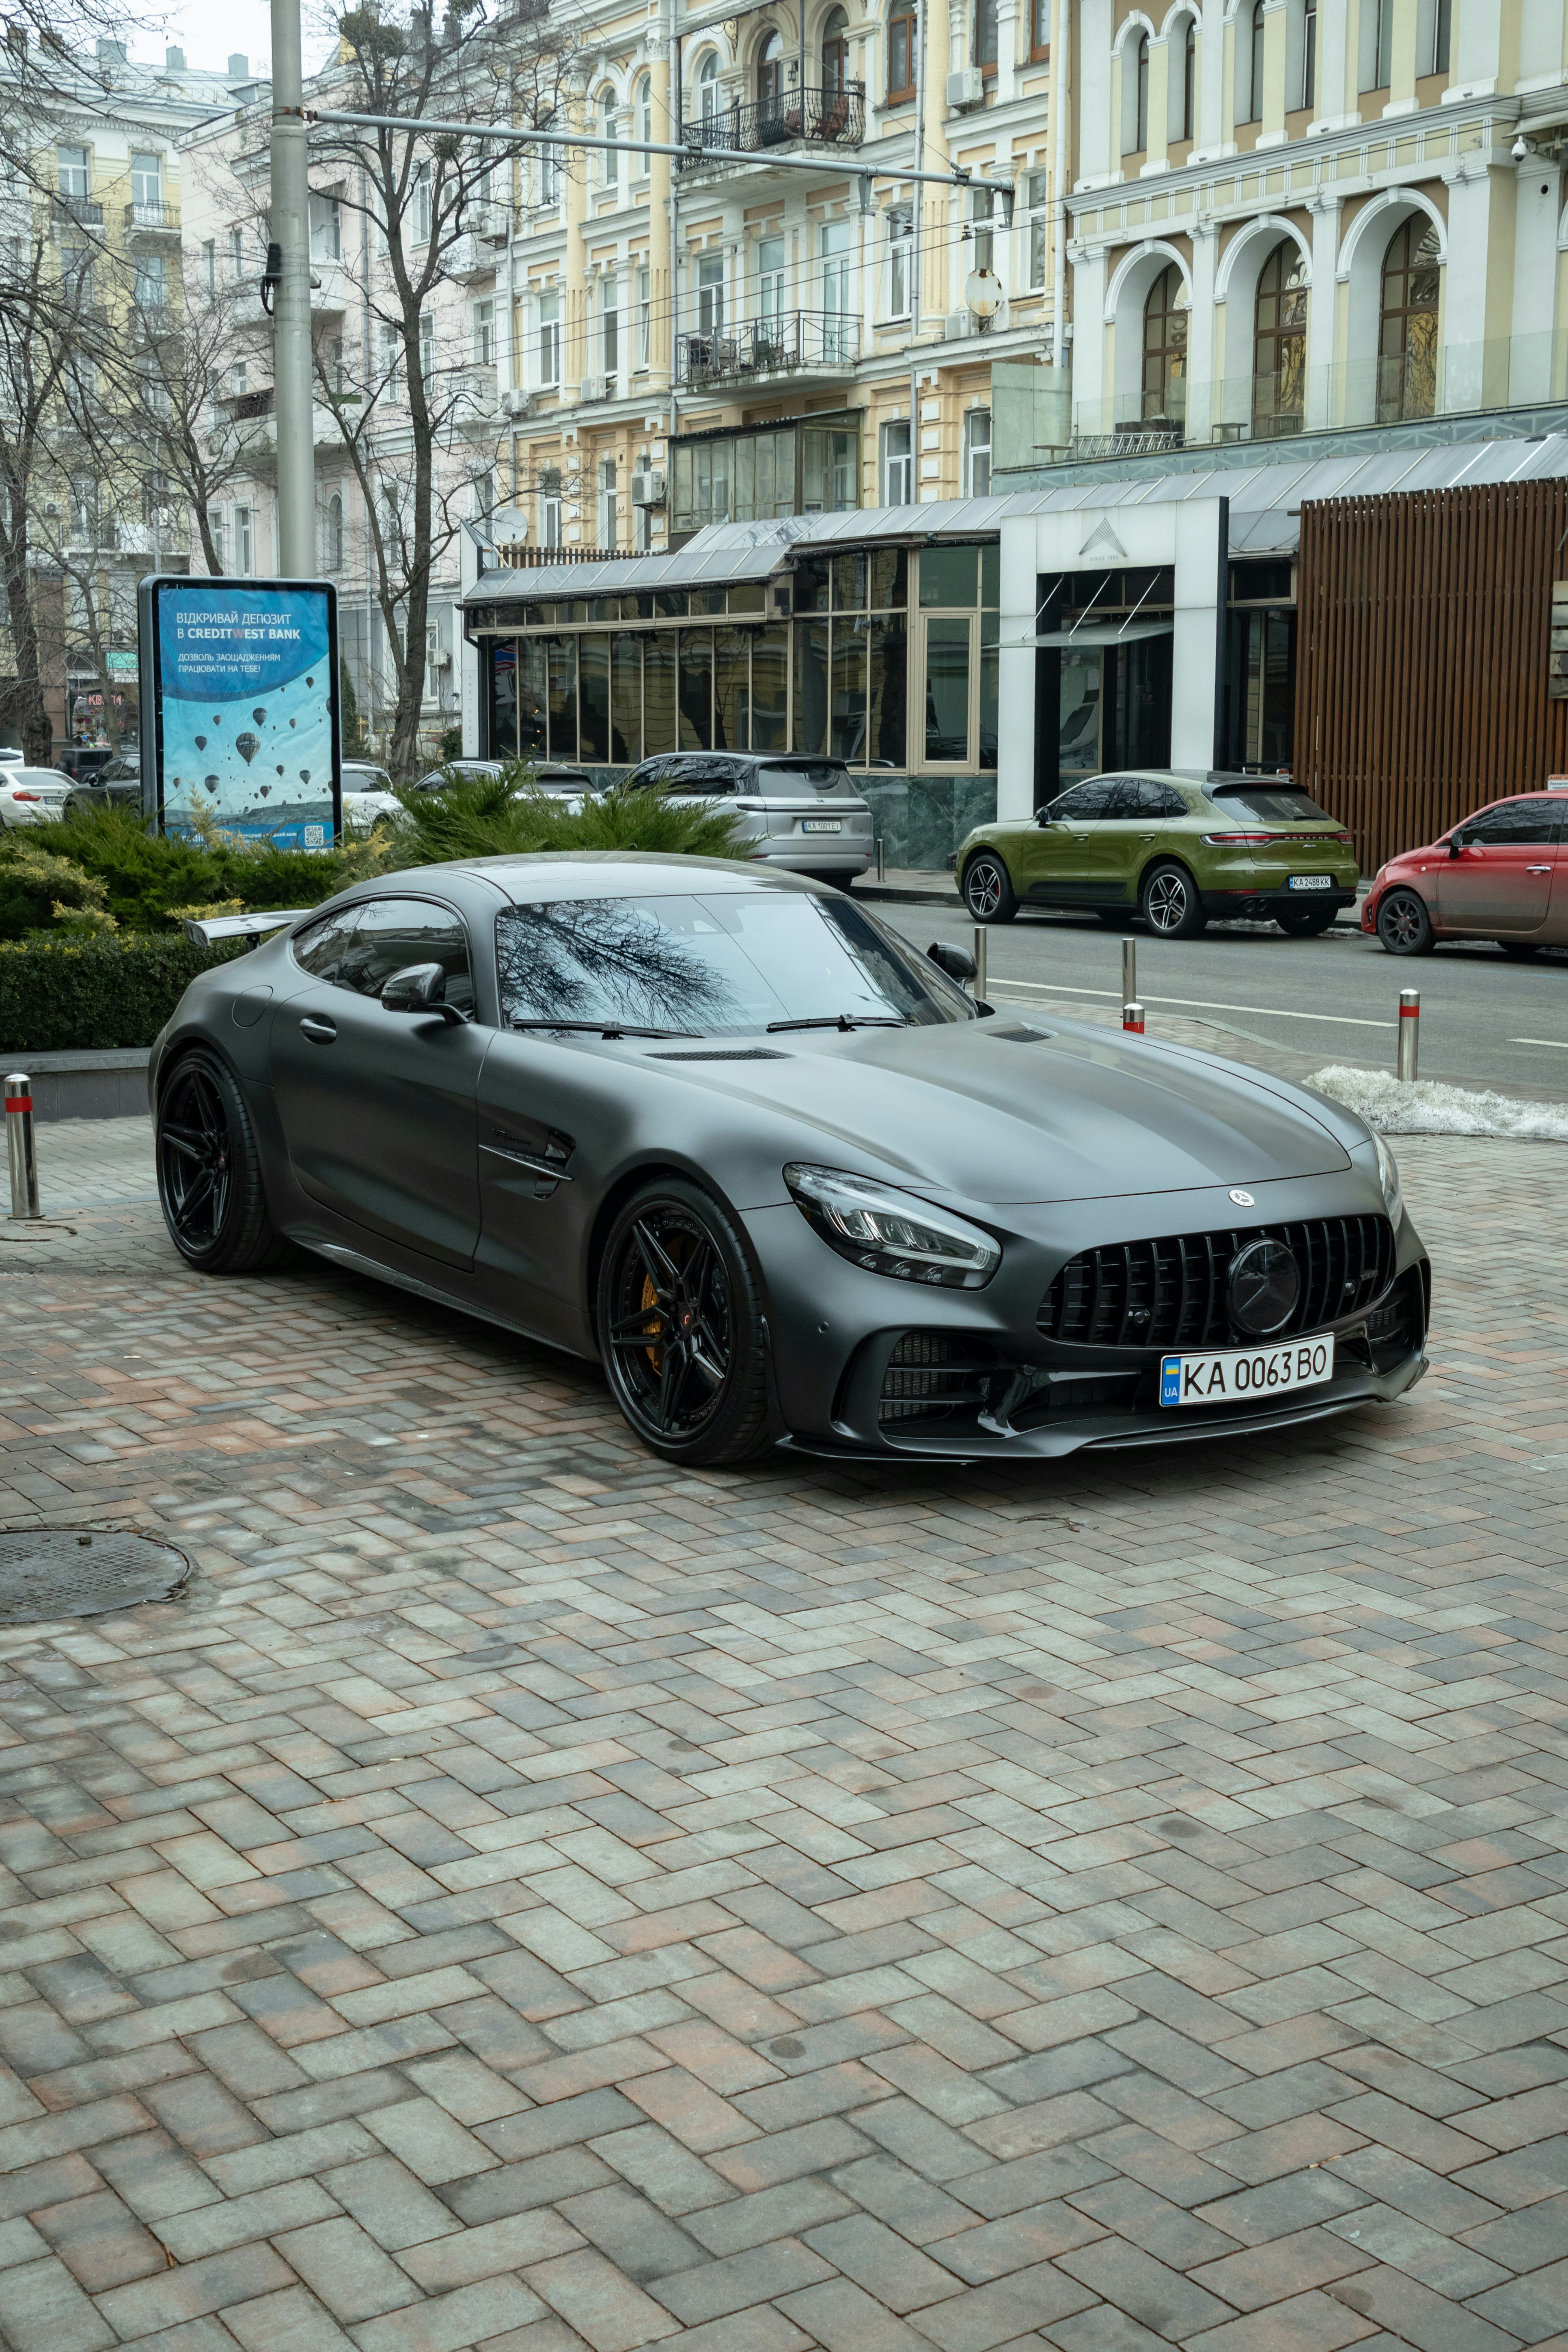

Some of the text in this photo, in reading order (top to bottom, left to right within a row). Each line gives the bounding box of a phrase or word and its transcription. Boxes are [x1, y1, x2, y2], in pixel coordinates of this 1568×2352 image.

[177, 611, 291, 625] ВІДКРИВАЙ ДЕПОЗИТ
[188, 628, 265, 639] CREDITWEST
[269, 629, 300, 639] BANK
[178, 654, 280, 662] ДОЗВОЛЬ ЗАОЩАДЖЕННЯМ
[179, 665, 225, 673] ПРАЦЮВАТИ
[1294, 878, 1303, 887] KA
[1305, 878, 1320, 886] 2488
[1320, 878, 1329, 886] KK
[1184, 1344, 1326, 1396] KA 0063 BO
[1165, 1386, 1178, 1398] UA
